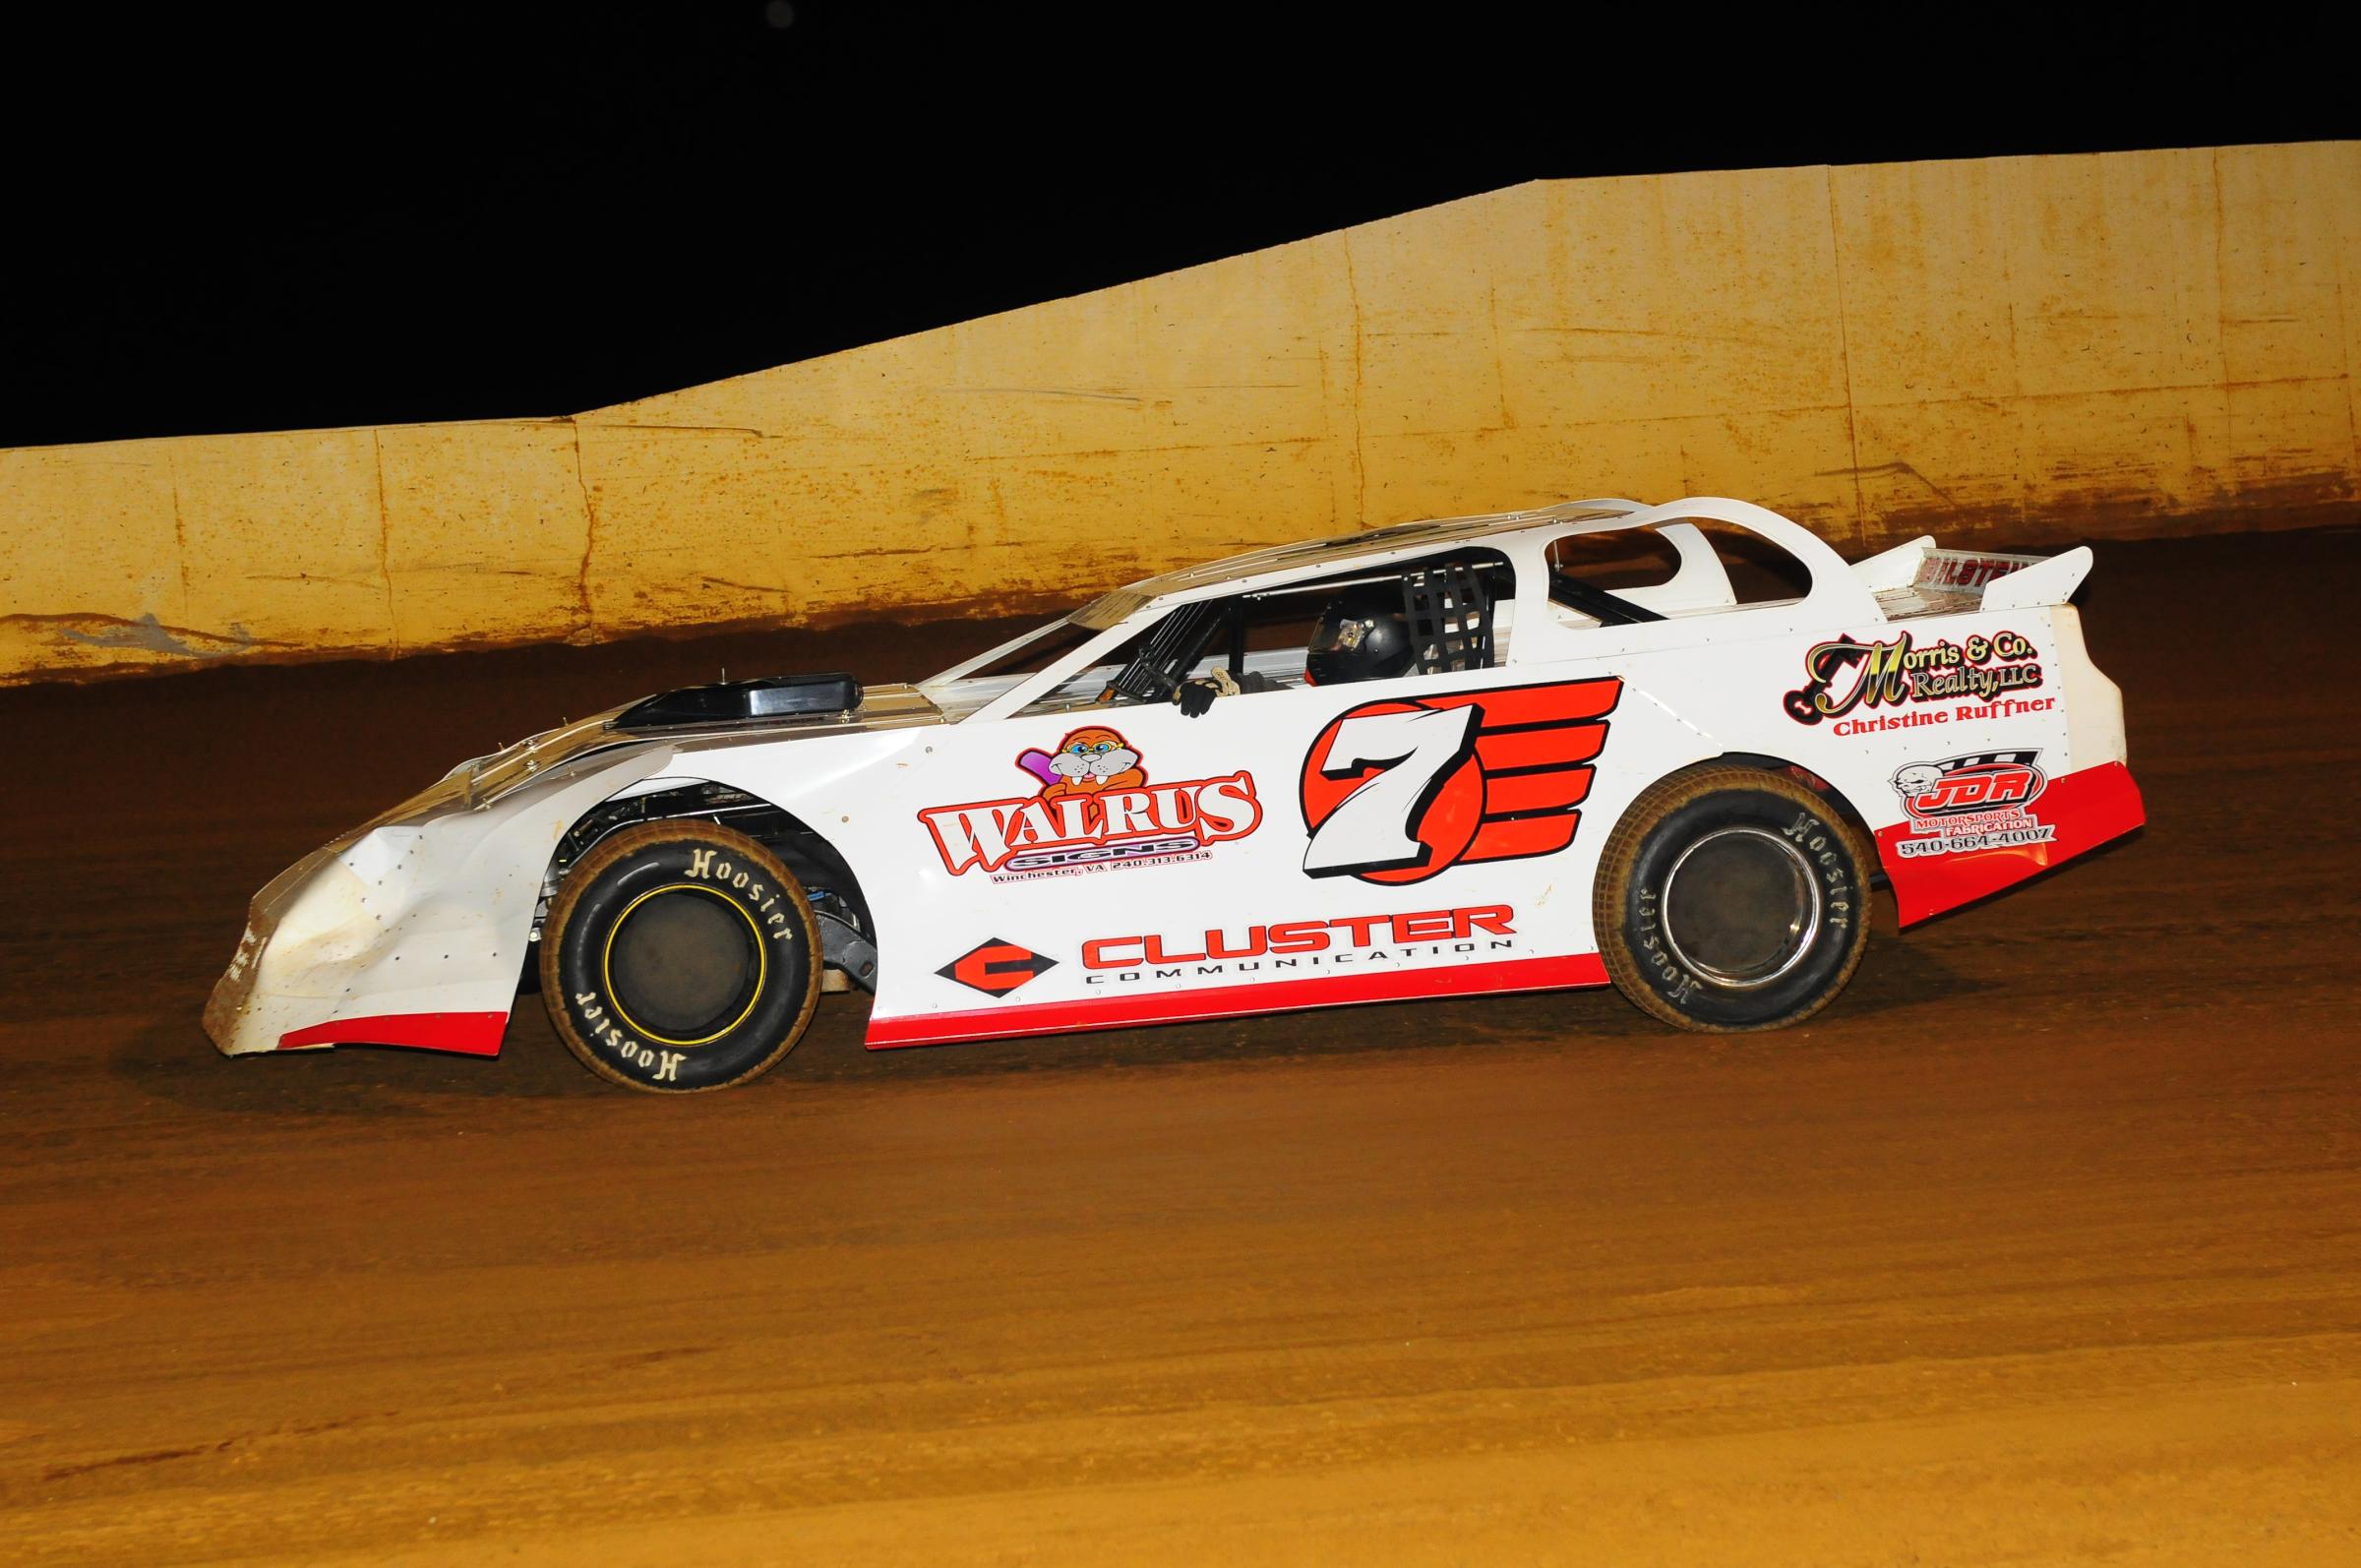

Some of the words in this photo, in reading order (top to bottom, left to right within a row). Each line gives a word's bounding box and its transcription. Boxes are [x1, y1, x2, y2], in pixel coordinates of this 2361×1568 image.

[1968, 636, 1989, 660] &
[1993, 632, 2033, 657] Co.
[1833, 710, 1949, 737] Christine
[1955, 696, 2056, 721] Ruffner
[1302, 702, 1485, 879] 7
[1914, 770, 2033, 810] JDR
[922, 772, 1260, 874] WALRUS
[1901, 827, 2051, 856] 540-664-4007
[1916, 810, 2021, 829] MOTORSPORTS
[1945, 817, 2034, 837] FABRICATION
[993, 867, 1083, 884] Winchester,
[1086, 862, 1106, 874] VA
[1011, 839, 1194, 868] SIGNS
[1781, 812, 1853, 930] Hoosier
[684, 847, 793, 940] Hoosier
[1081, 903, 1517, 970] CLUSTER
[1635, 888, 1703, 1005] Hoosier
[1085, 938, 1513, 985] COMMUNICATION
[575, 991, 688, 1082] Hoosier
